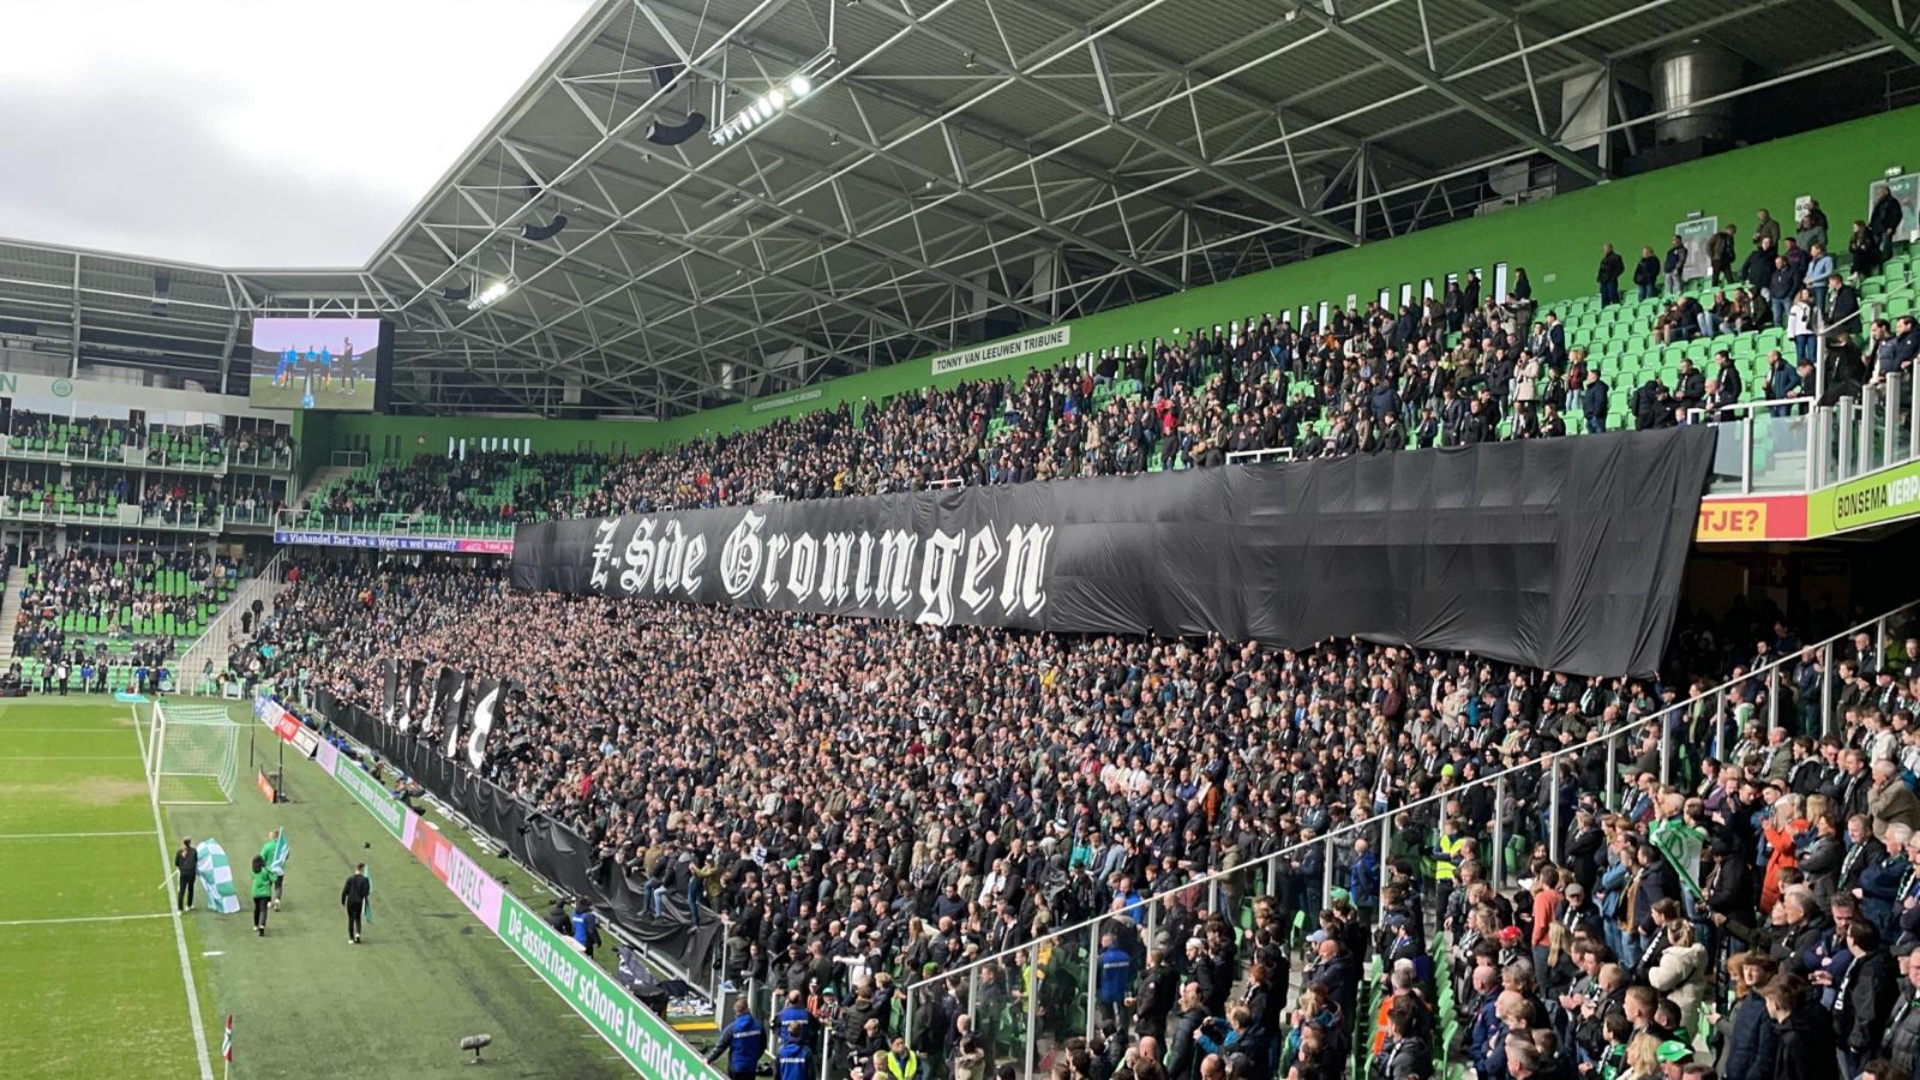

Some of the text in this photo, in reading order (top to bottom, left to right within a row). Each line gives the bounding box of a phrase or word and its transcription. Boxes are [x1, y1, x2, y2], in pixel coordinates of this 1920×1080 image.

[936, 331, 1063, 371] TONNY VAN LEEUWEN TRIBUNE
[720, 510, 1054, 627] Groningen
[508, 907, 522, 943] Dé
[522, 925, 551, 970] assist
[551, 949, 579, 992] naar
[578, 974, 624, 1037] schone
